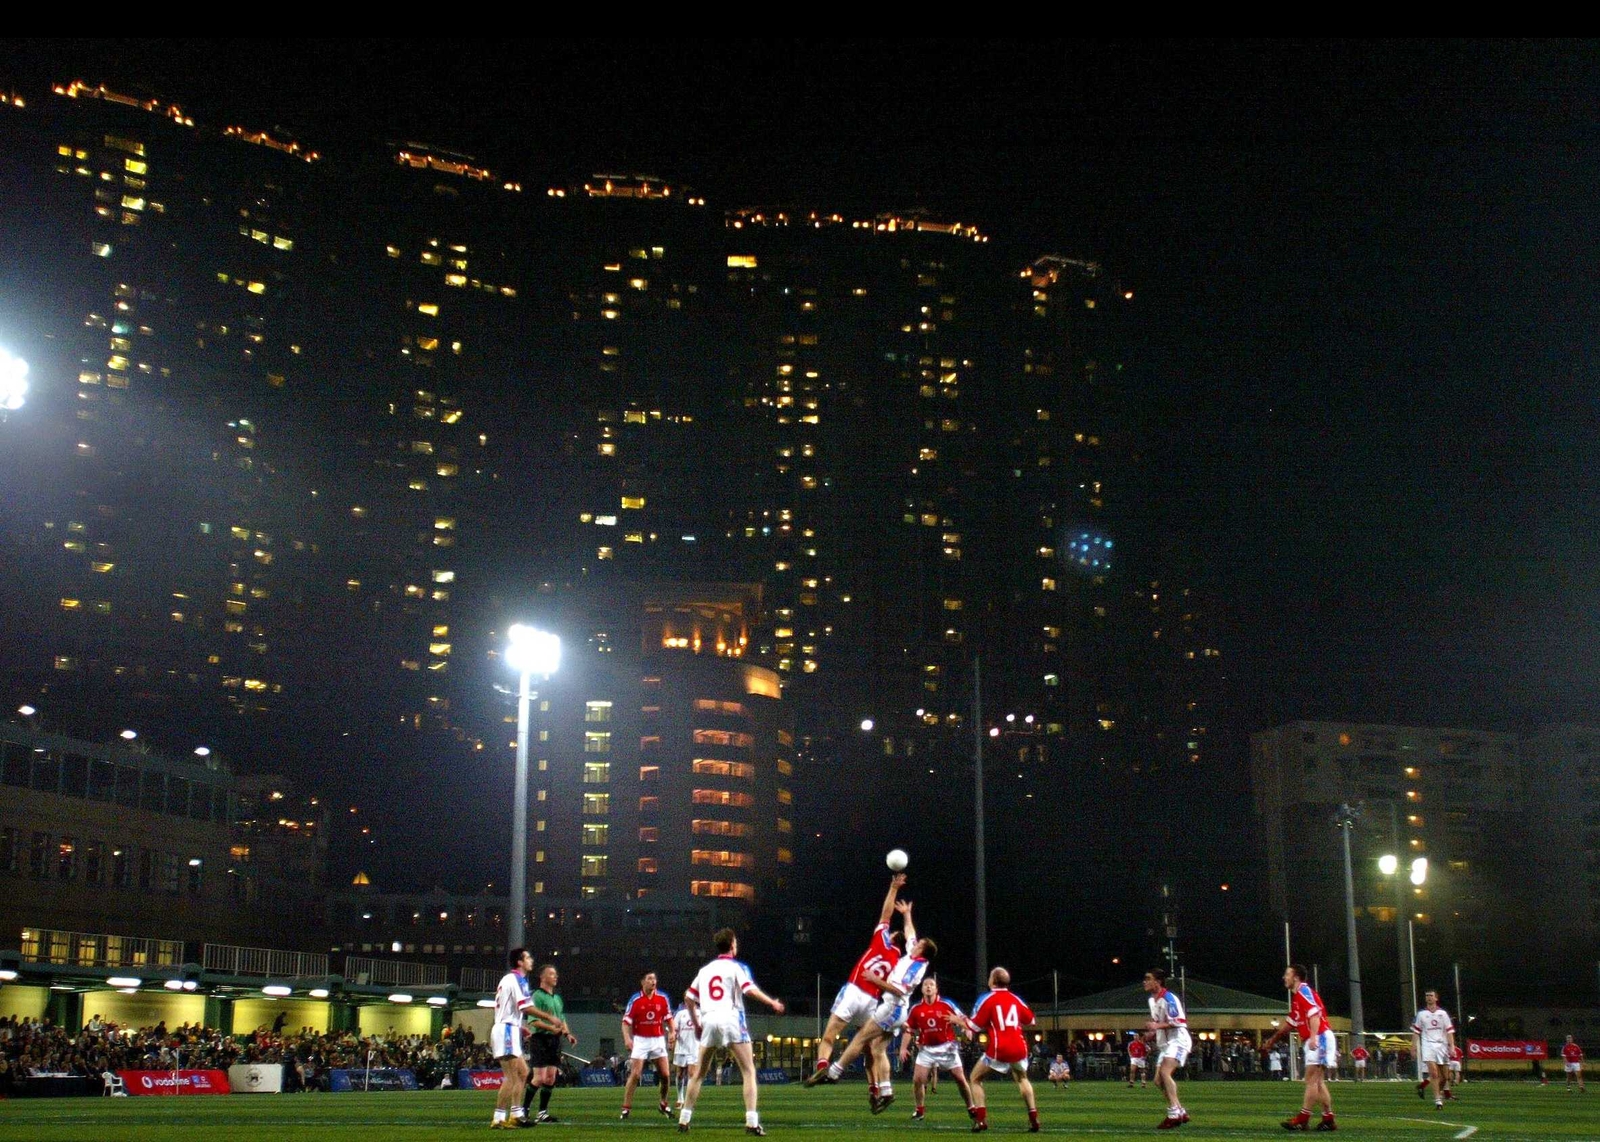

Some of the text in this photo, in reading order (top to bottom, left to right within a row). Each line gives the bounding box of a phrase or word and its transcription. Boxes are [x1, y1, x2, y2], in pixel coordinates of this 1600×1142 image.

[863, 954, 891, 979] 16
[708, 975, 724, 1001] 6
[995, 1004, 1018, 1031] 14
[1482, 1045, 1521, 1053] vodafone
